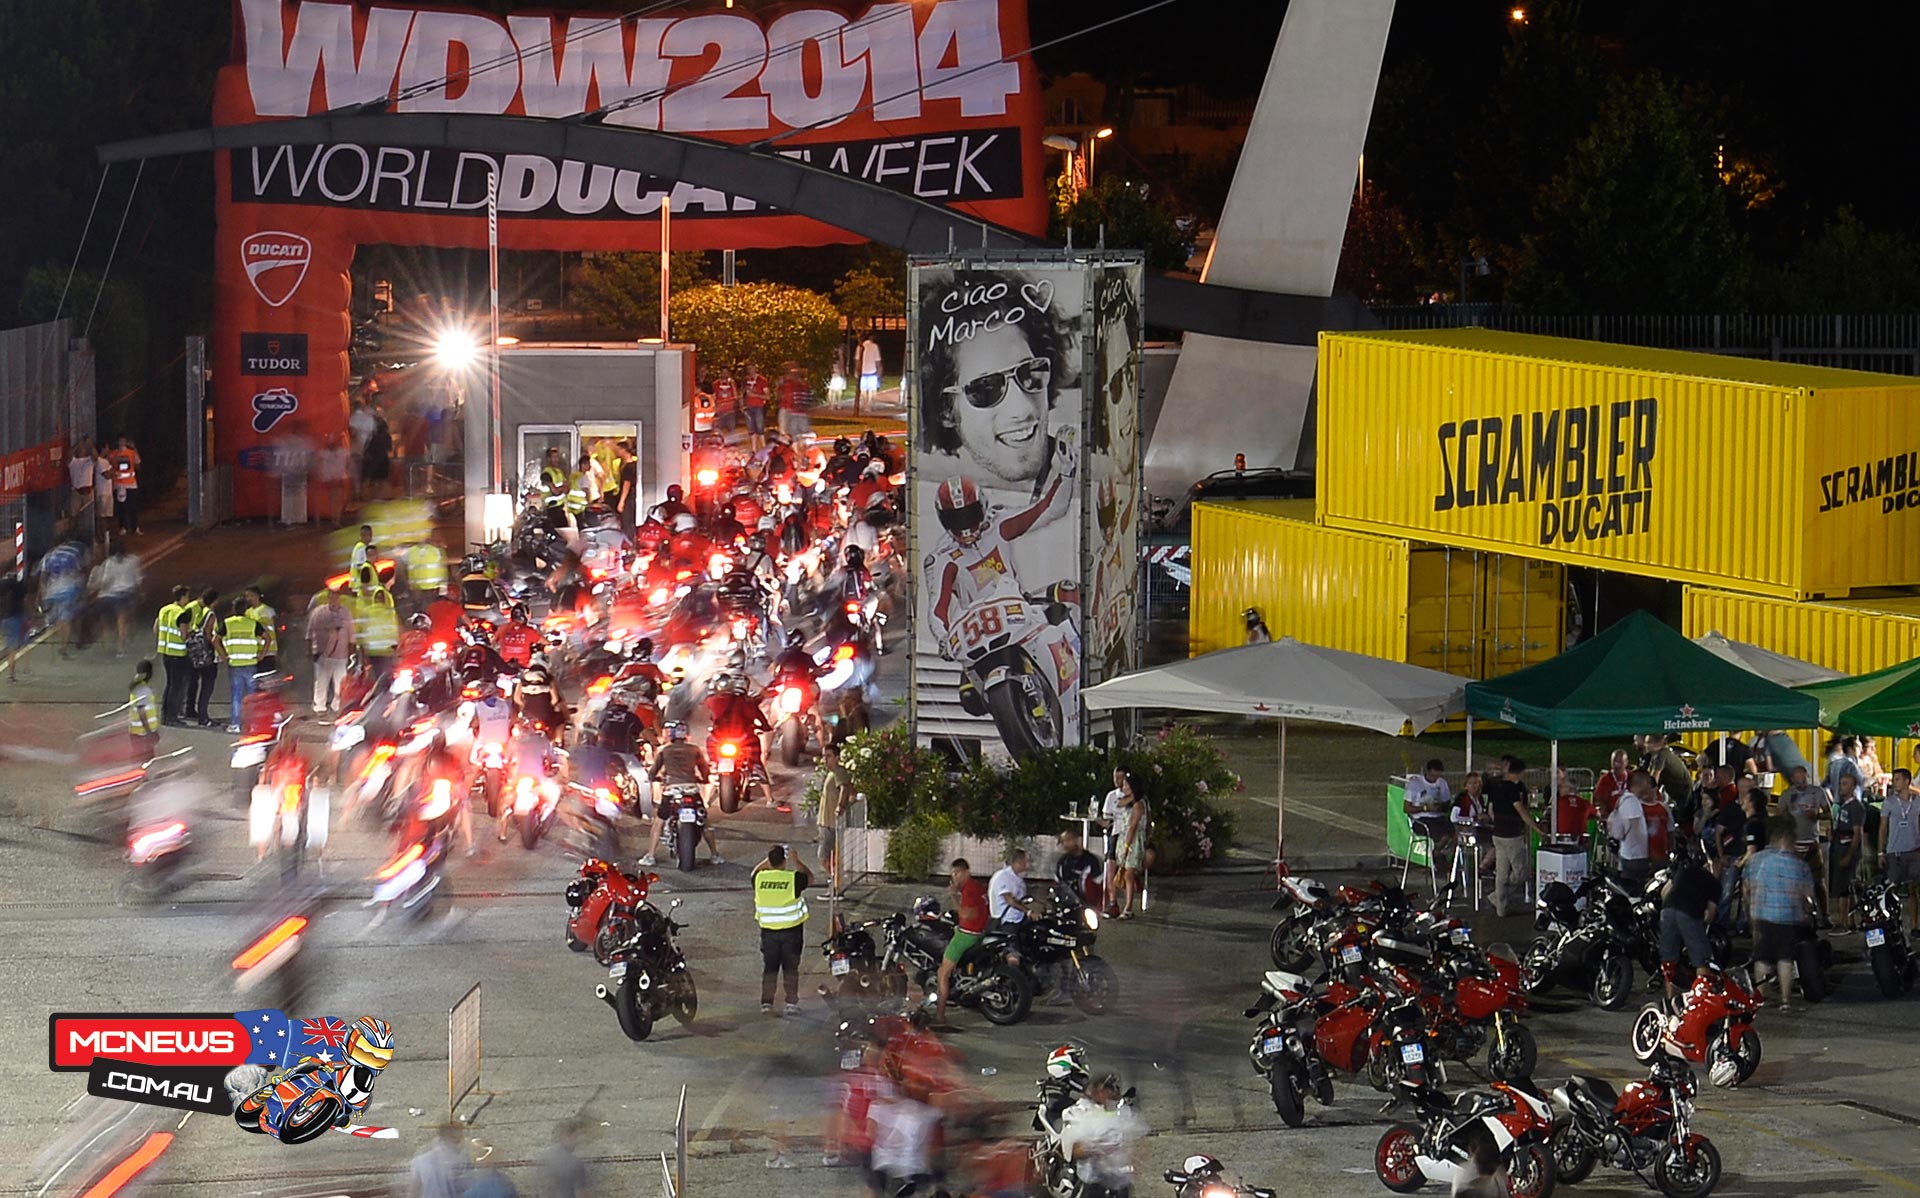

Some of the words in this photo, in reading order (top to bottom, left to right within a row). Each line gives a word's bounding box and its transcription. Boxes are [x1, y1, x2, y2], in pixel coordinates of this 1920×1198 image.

[241, 0, 1021, 131] WDW2014
[248, 243, 304, 256] DUCATI
[928, 307, 1026, 352] Marco
[247, 358, 301, 370] TUDOR
[1434, 397, 1658, 512] SCRAMBLER
[1539, 489, 1653, 546] DUCATI
[962, 606, 1003, 647] 58
[1663, 718, 1711, 730] Heineken
[760, 881, 790, 890] SERVICE
